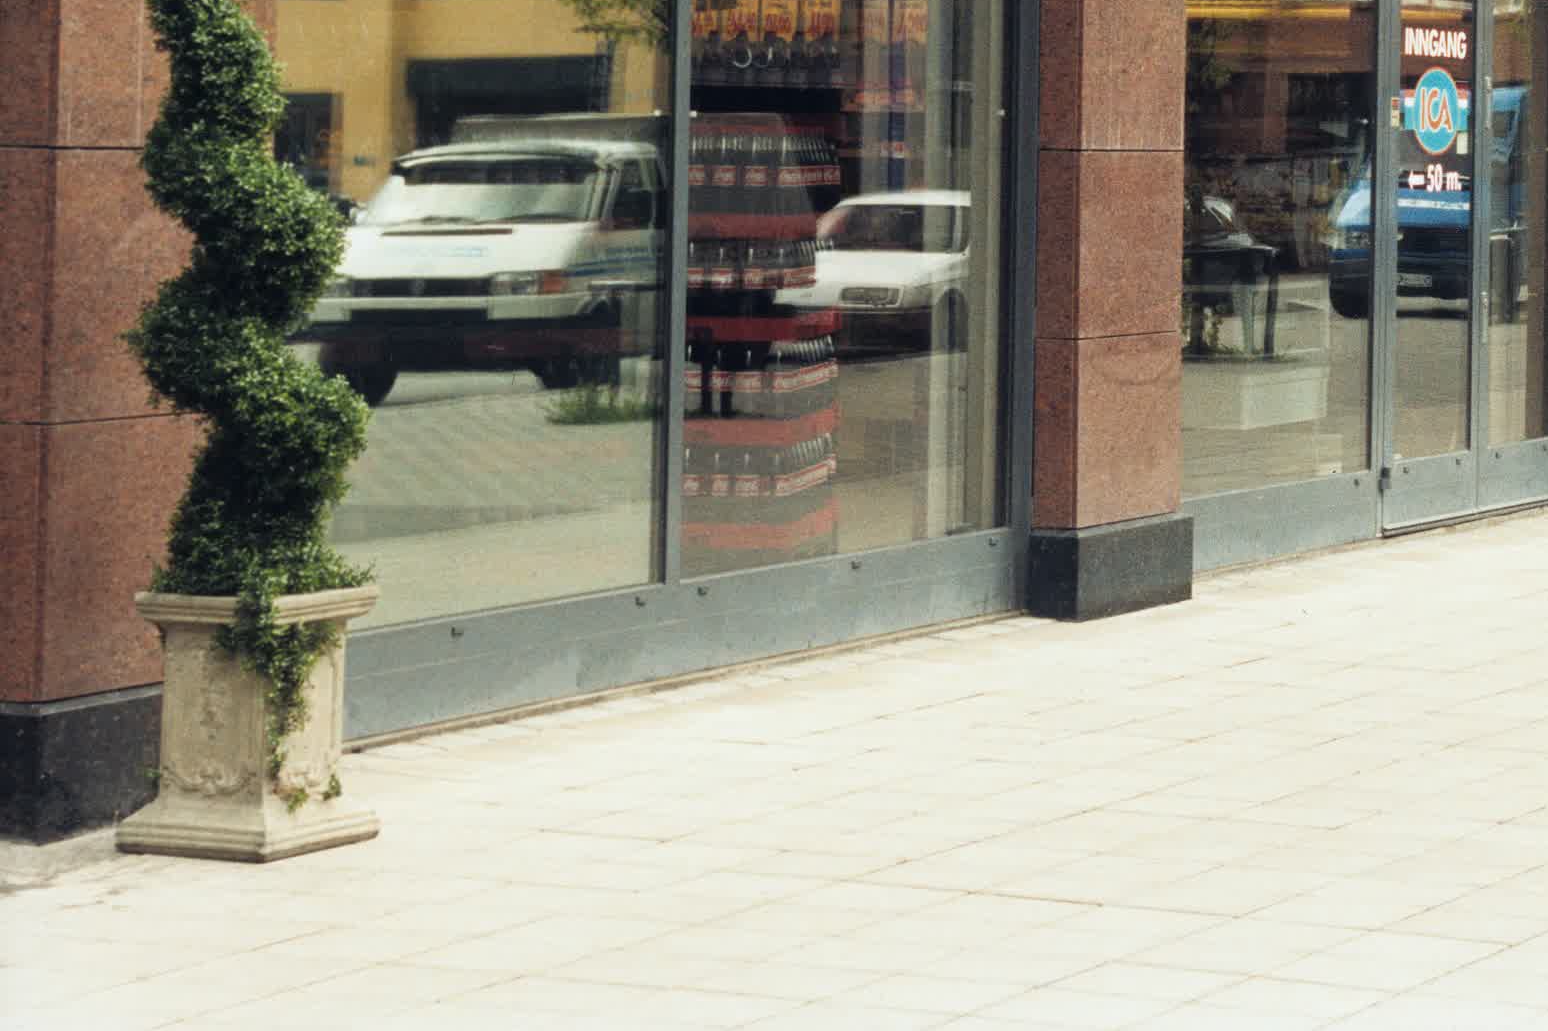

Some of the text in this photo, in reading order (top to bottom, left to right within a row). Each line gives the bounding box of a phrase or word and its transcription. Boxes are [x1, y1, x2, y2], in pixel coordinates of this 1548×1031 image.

[1404, 27, 1467, 59] INNGANG
[1419, 86, 1453, 132] ICA
[1426, 163, 1443, 192] 50
